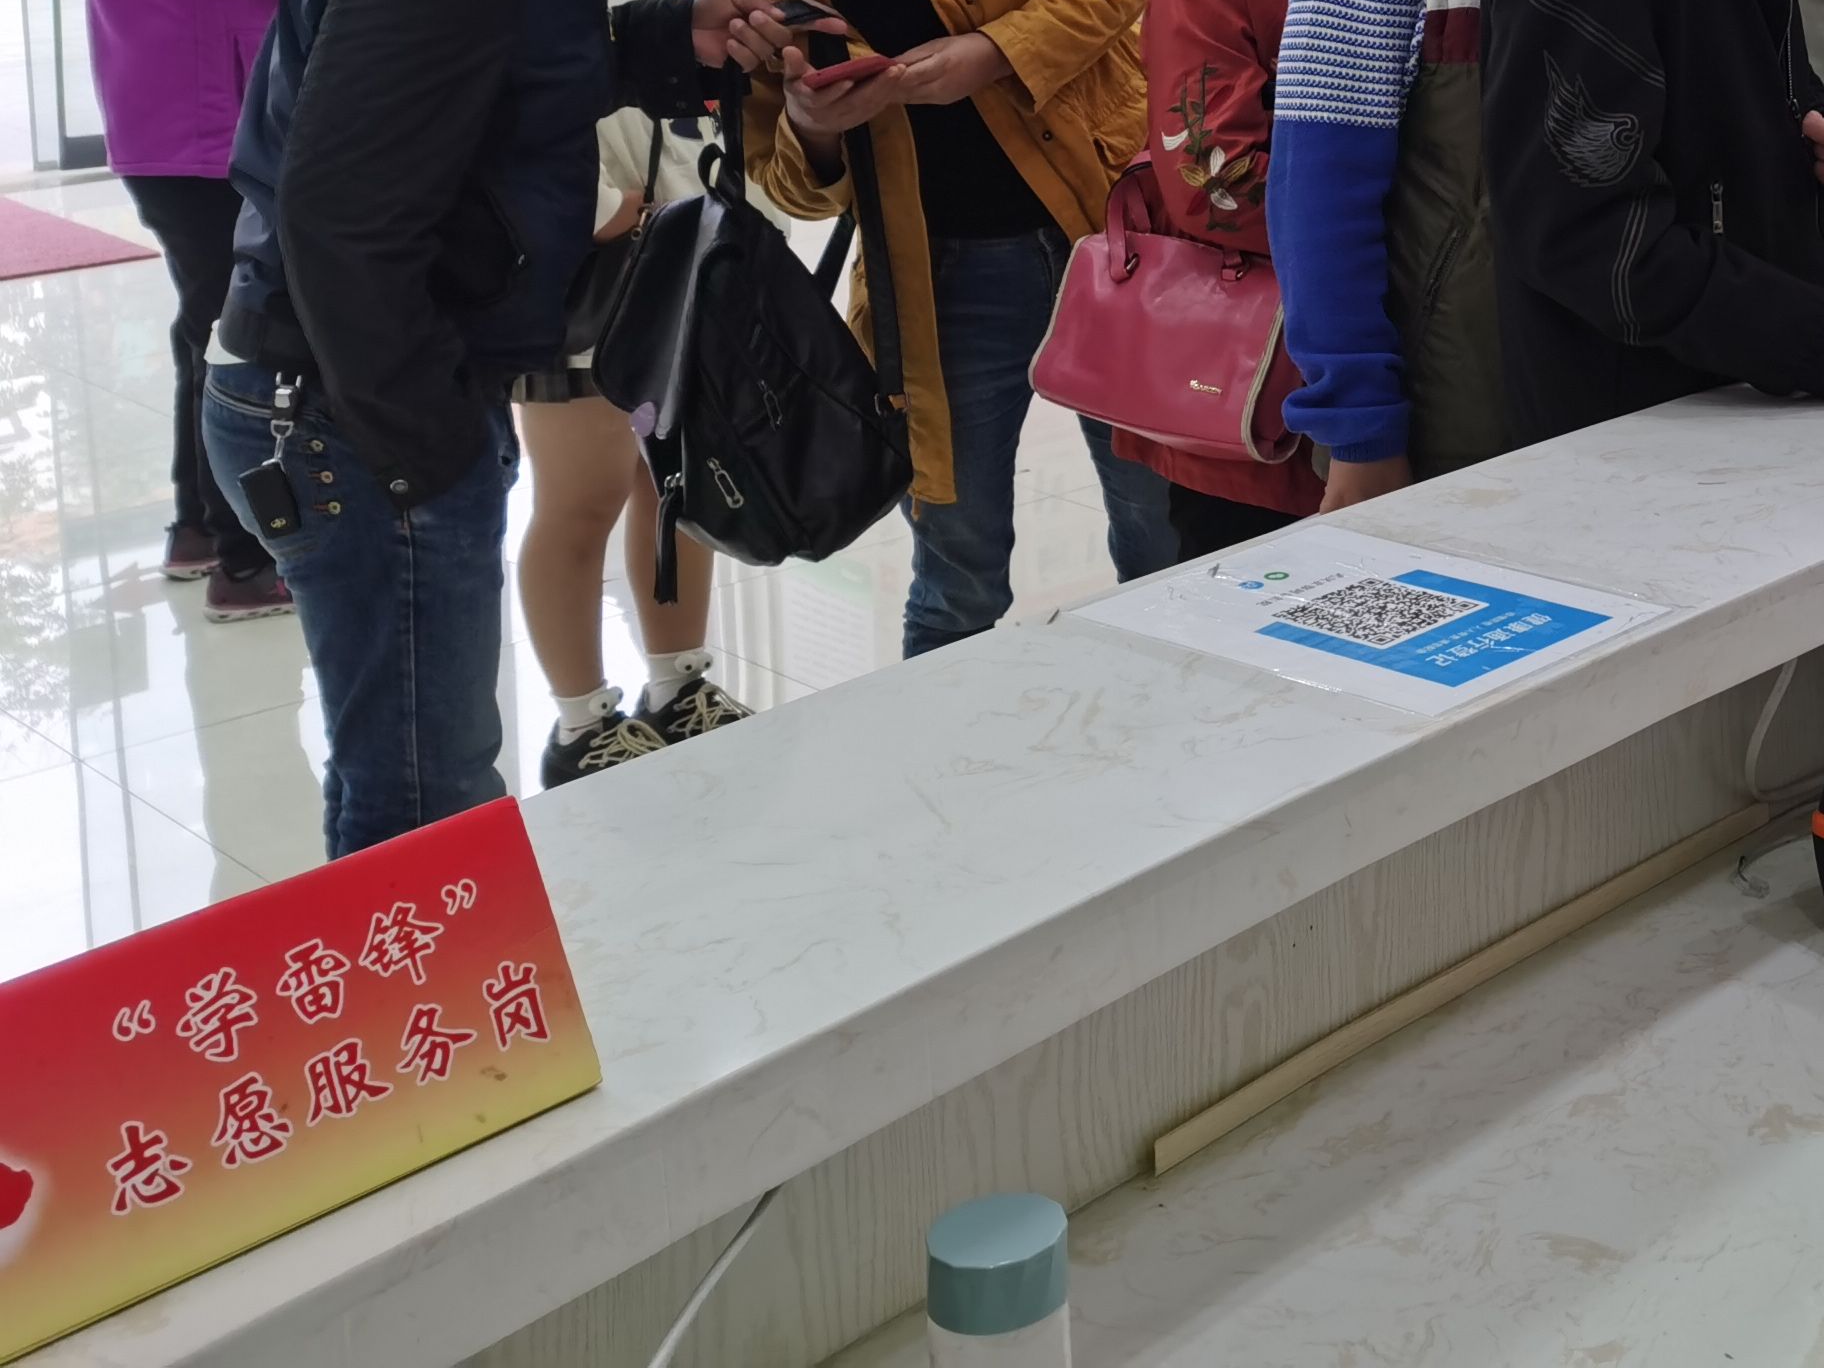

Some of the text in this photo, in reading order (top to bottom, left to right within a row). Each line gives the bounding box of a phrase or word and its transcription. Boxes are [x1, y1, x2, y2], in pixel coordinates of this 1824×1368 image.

[107, 962, 552, 1214] 志愿服务岗
